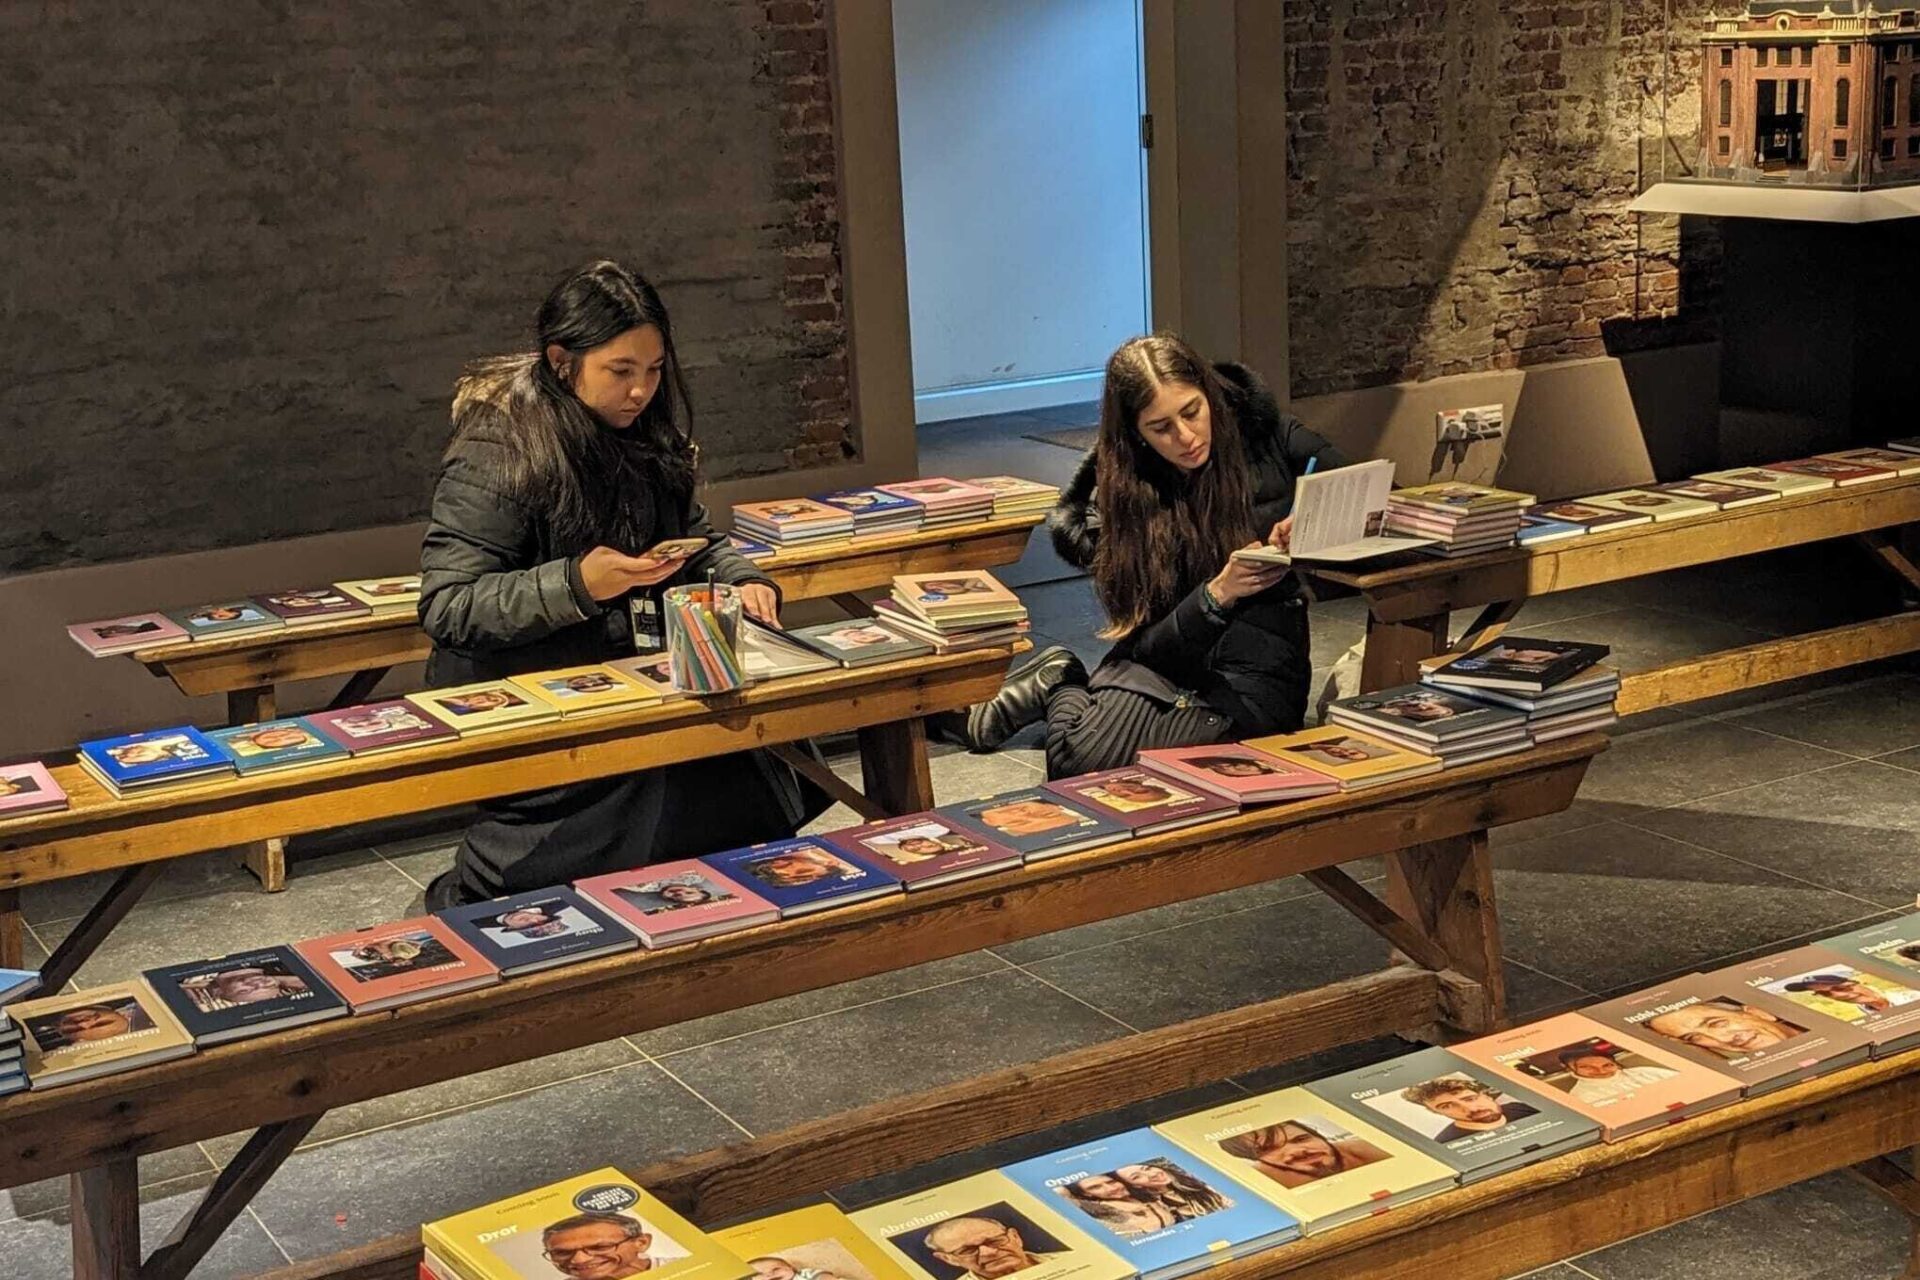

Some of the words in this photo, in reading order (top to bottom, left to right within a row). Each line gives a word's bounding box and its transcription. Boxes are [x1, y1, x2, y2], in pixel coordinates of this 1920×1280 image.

[1351, 1086, 1380, 1102] Guy
[1044, 1169, 1090, 1188] Oryon
[878, 1208, 950, 1237] Abraham
[476, 1224, 519, 1245] Dror
